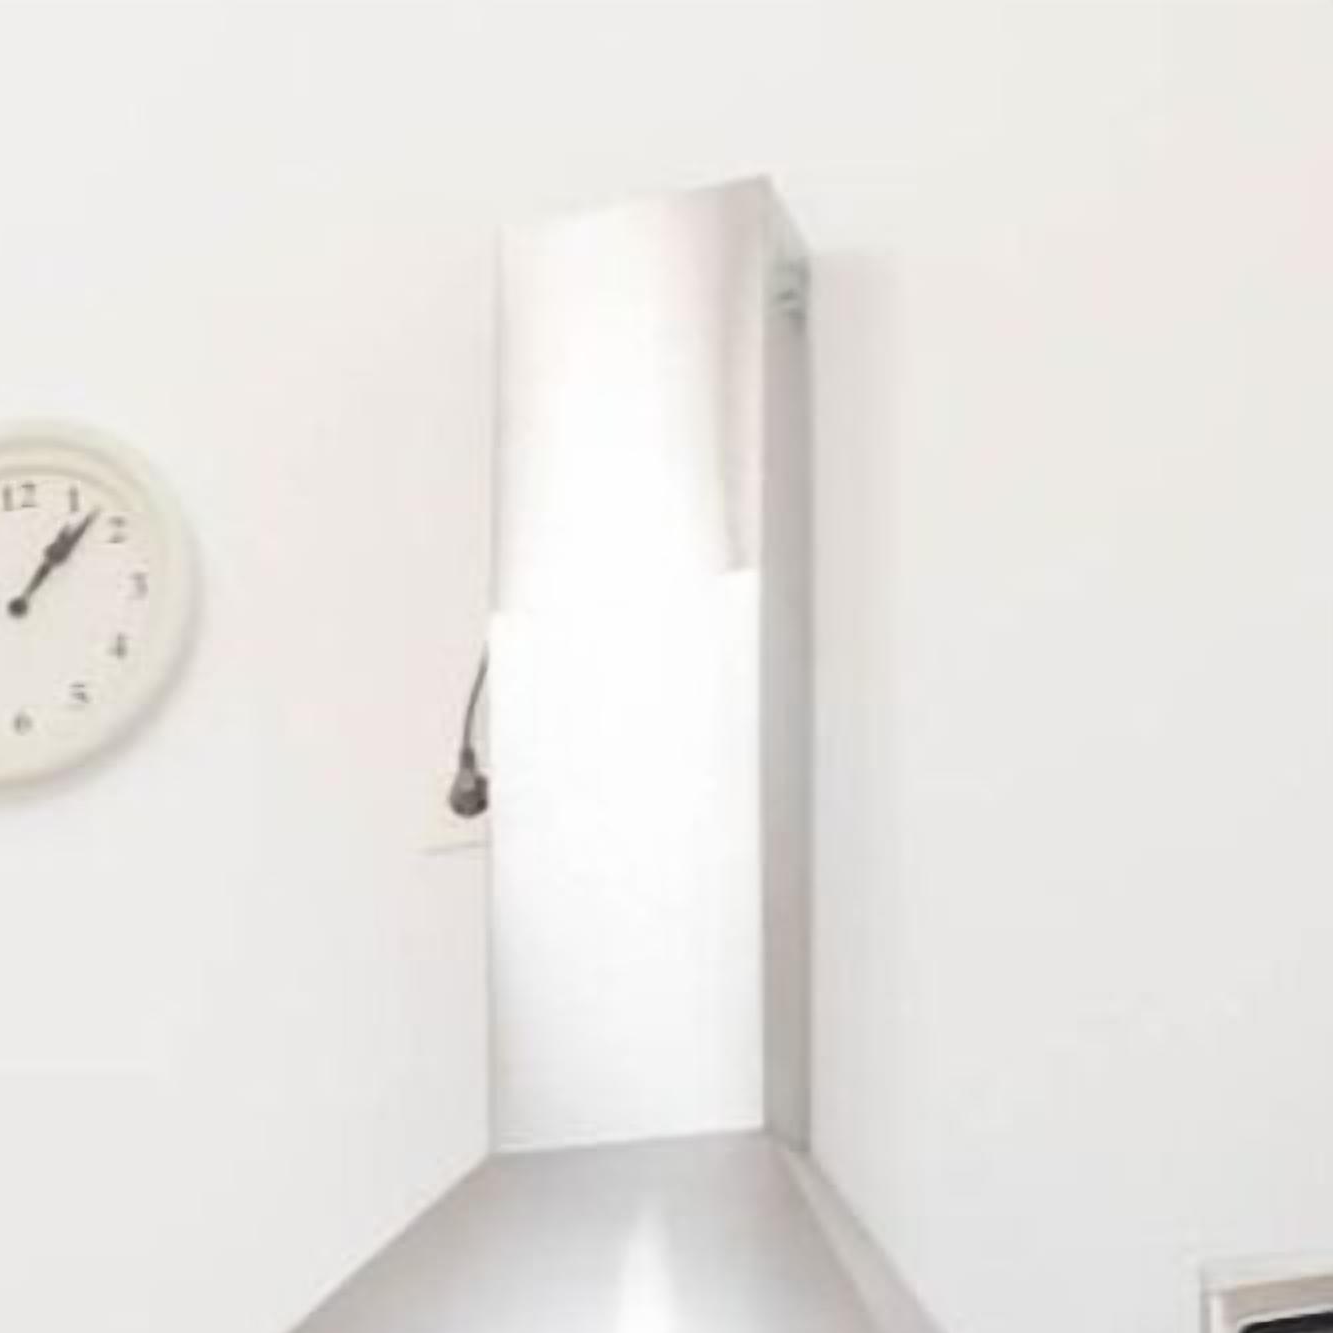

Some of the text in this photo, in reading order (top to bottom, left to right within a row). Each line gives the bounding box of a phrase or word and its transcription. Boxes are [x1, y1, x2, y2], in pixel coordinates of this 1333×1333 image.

[1, 482, 37, 512] 12
[67, 486, 81, 514] 1
[108, 516, 128, 544] 2
